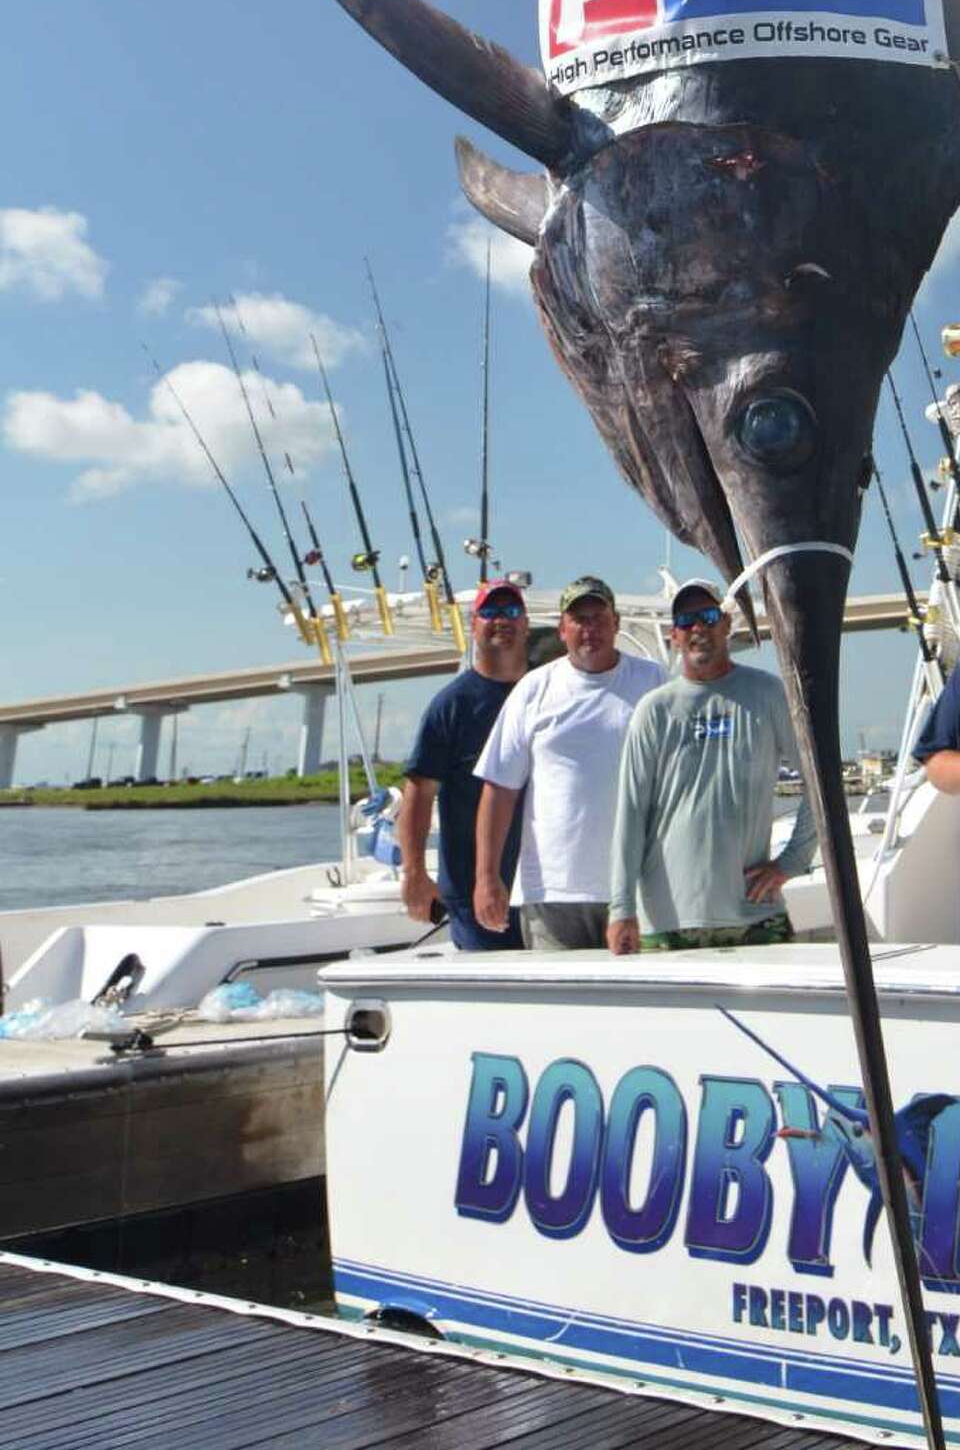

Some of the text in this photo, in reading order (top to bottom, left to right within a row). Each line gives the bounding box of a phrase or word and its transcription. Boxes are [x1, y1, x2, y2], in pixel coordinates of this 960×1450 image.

[548, 22, 930, 86] High Performance Offshore Gear
[732, 1282, 902, 1355] FREEPORT,
